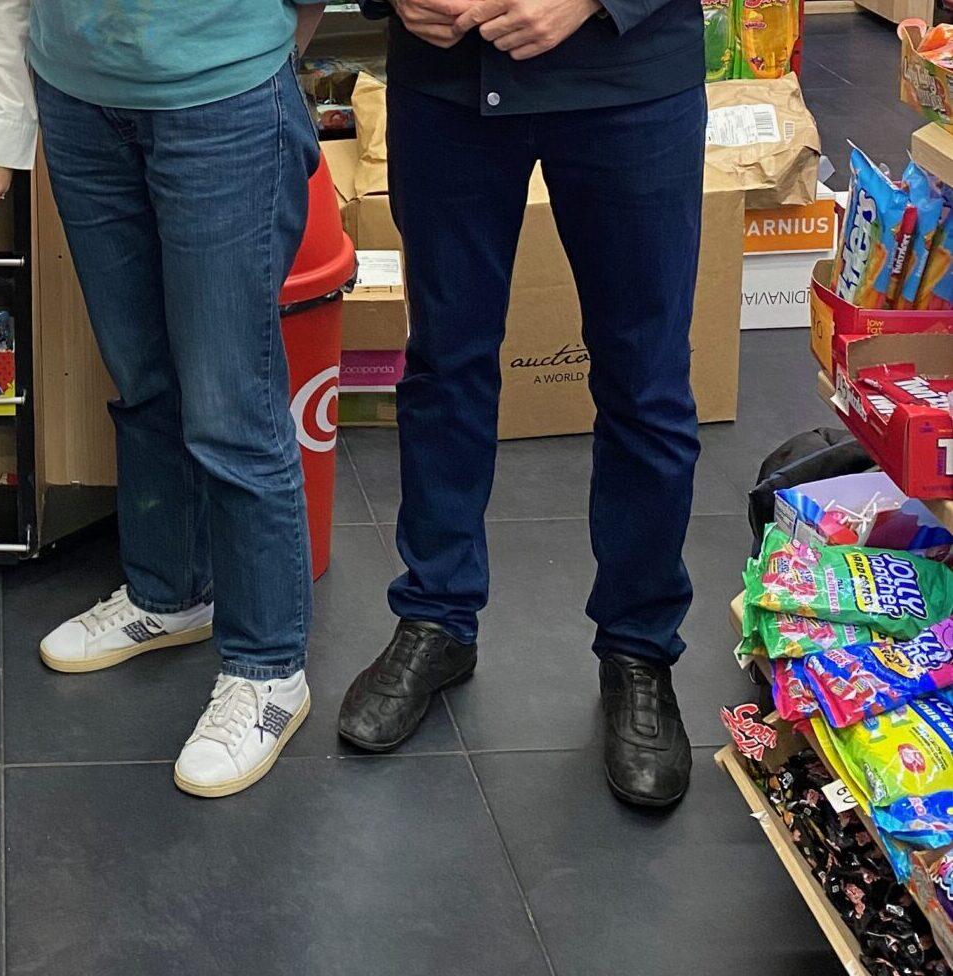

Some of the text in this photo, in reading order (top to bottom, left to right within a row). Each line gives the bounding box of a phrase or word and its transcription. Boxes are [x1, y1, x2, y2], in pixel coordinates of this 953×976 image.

[740, 289, 810, 306] DINAVIA
[867, 319, 884, 328] low
[510, 344, 590, 368] auctio
[341, 364, 395, 374] Cocopanda
[534, 372, 584, 384] A WORLD
[883, 554, 927, 616] JOLLY
[734, 704, 777, 749] SUPER
